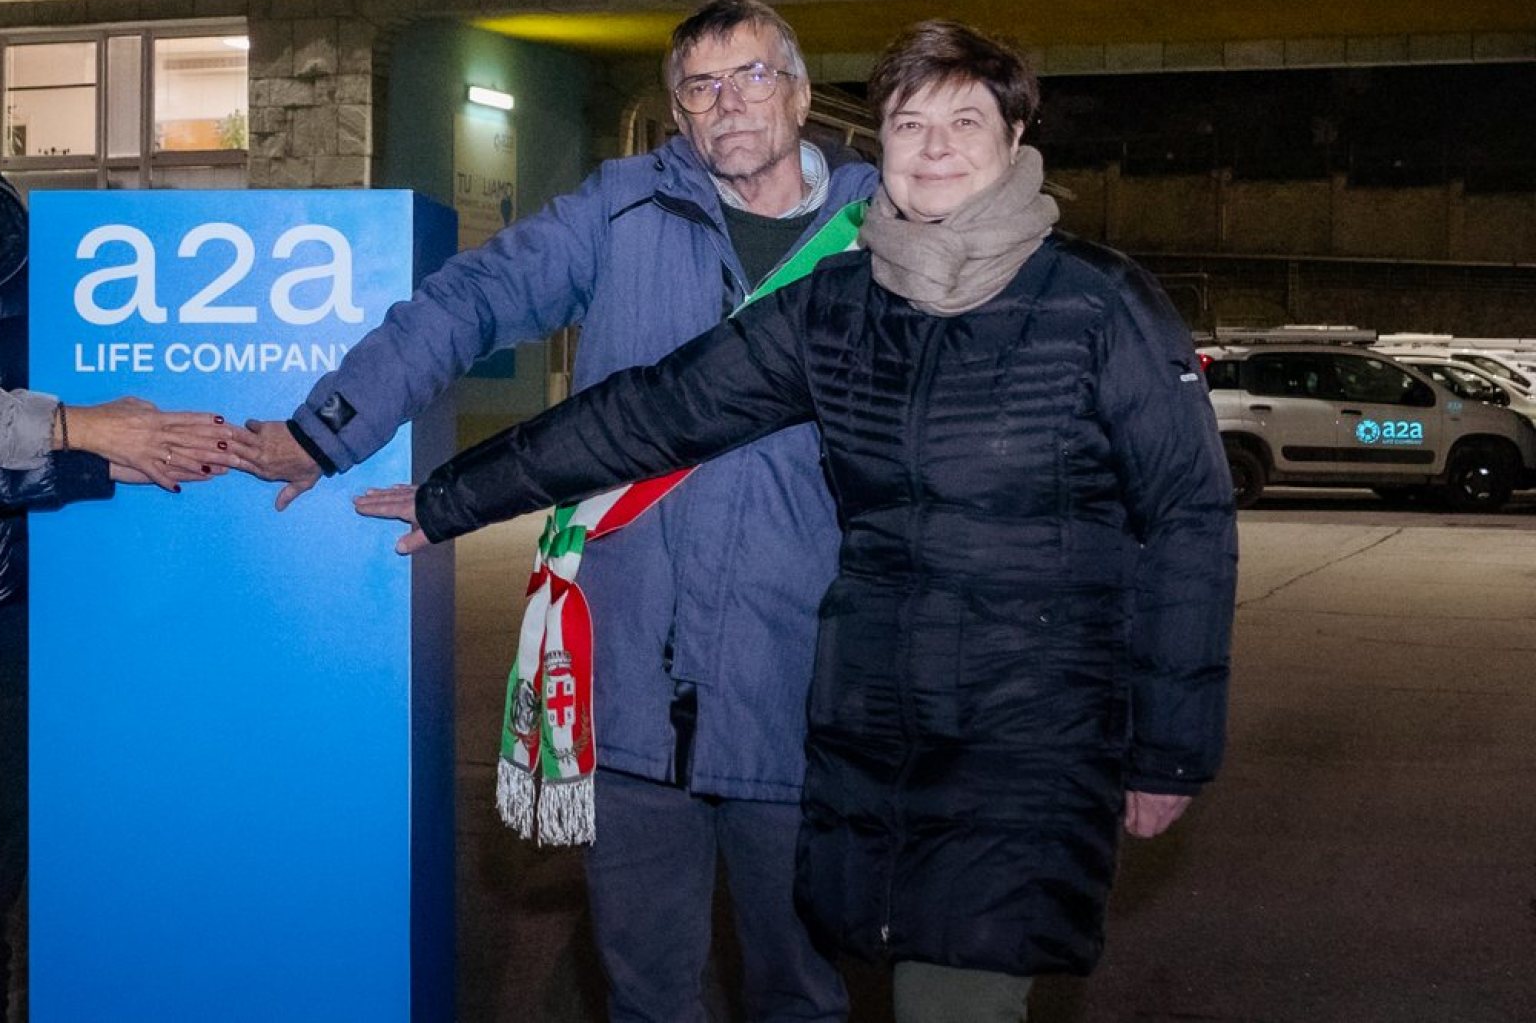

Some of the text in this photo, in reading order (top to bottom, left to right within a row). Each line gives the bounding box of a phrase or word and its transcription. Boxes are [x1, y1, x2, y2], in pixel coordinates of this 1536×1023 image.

[73, 222, 365, 326] a2a
[75, 343, 154, 373] LIFE
[1382, 421, 1423, 439] a2a
